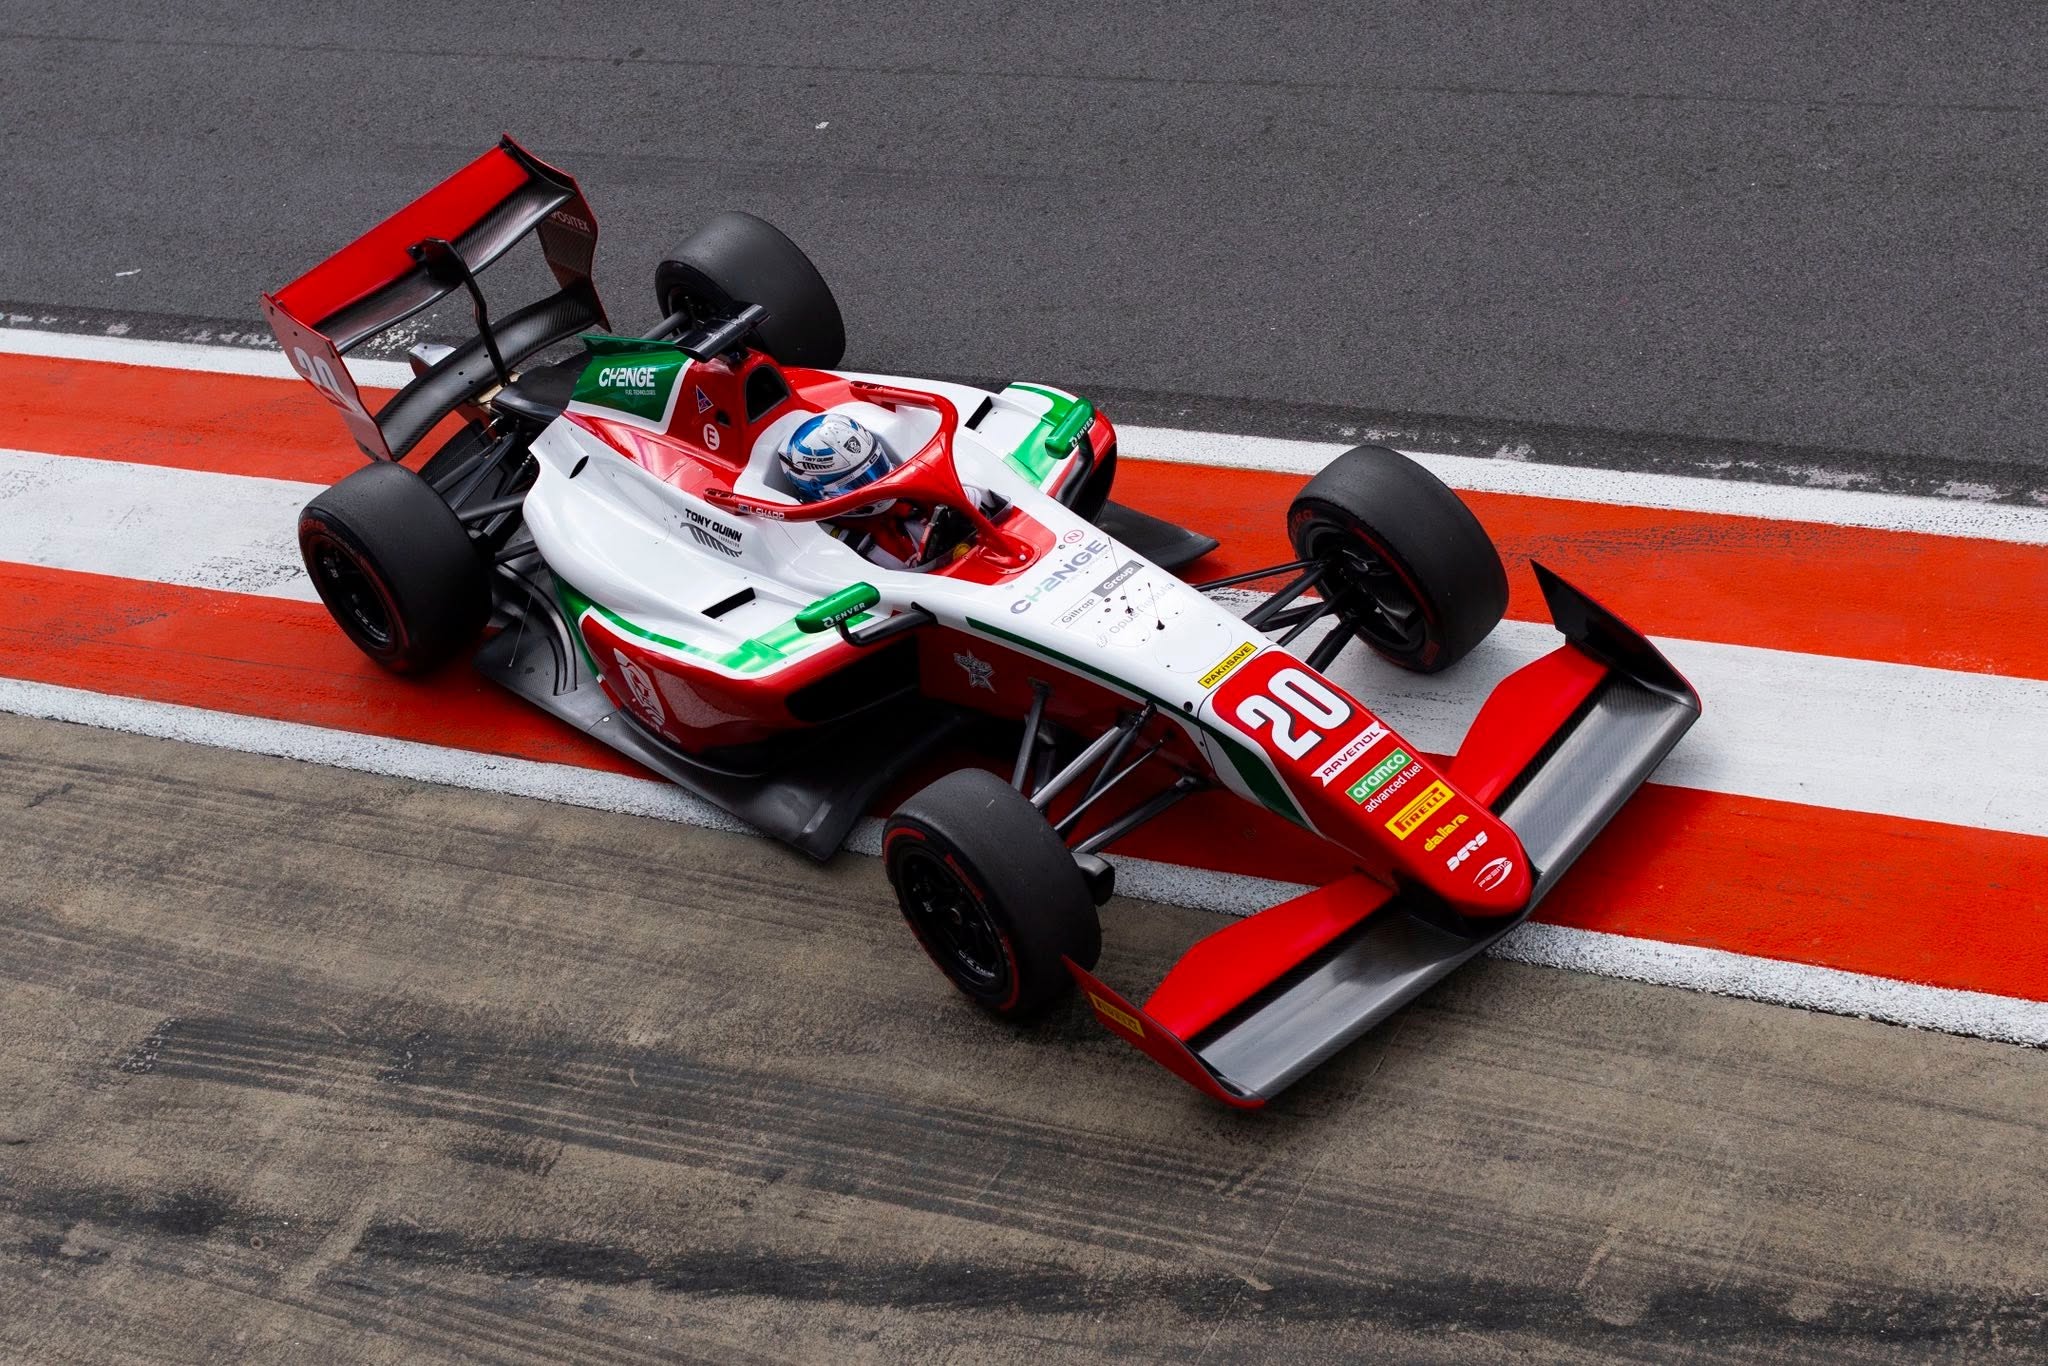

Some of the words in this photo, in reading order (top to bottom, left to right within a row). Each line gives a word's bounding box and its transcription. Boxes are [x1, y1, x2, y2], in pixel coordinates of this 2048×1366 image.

[685, 508, 712, 528] TONY
[711, 521, 743, 543] QUINN
[821, 602, 866, 628] DENVER
[1061, 598, 1095, 624] Giltrap
[1102, 566, 1134, 590] Group
[1235, 667, 1354, 761] 20
[1322, 730, 1381, 777] RAVENOL
[1352, 754, 1406, 798] aramco
[1364, 775, 1408, 813] advanced
[1402, 761, 1424, 780] fuel
[1393, 786, 1446, 833] PIRELLI
[1423, 813, 1470, 852] dallara
